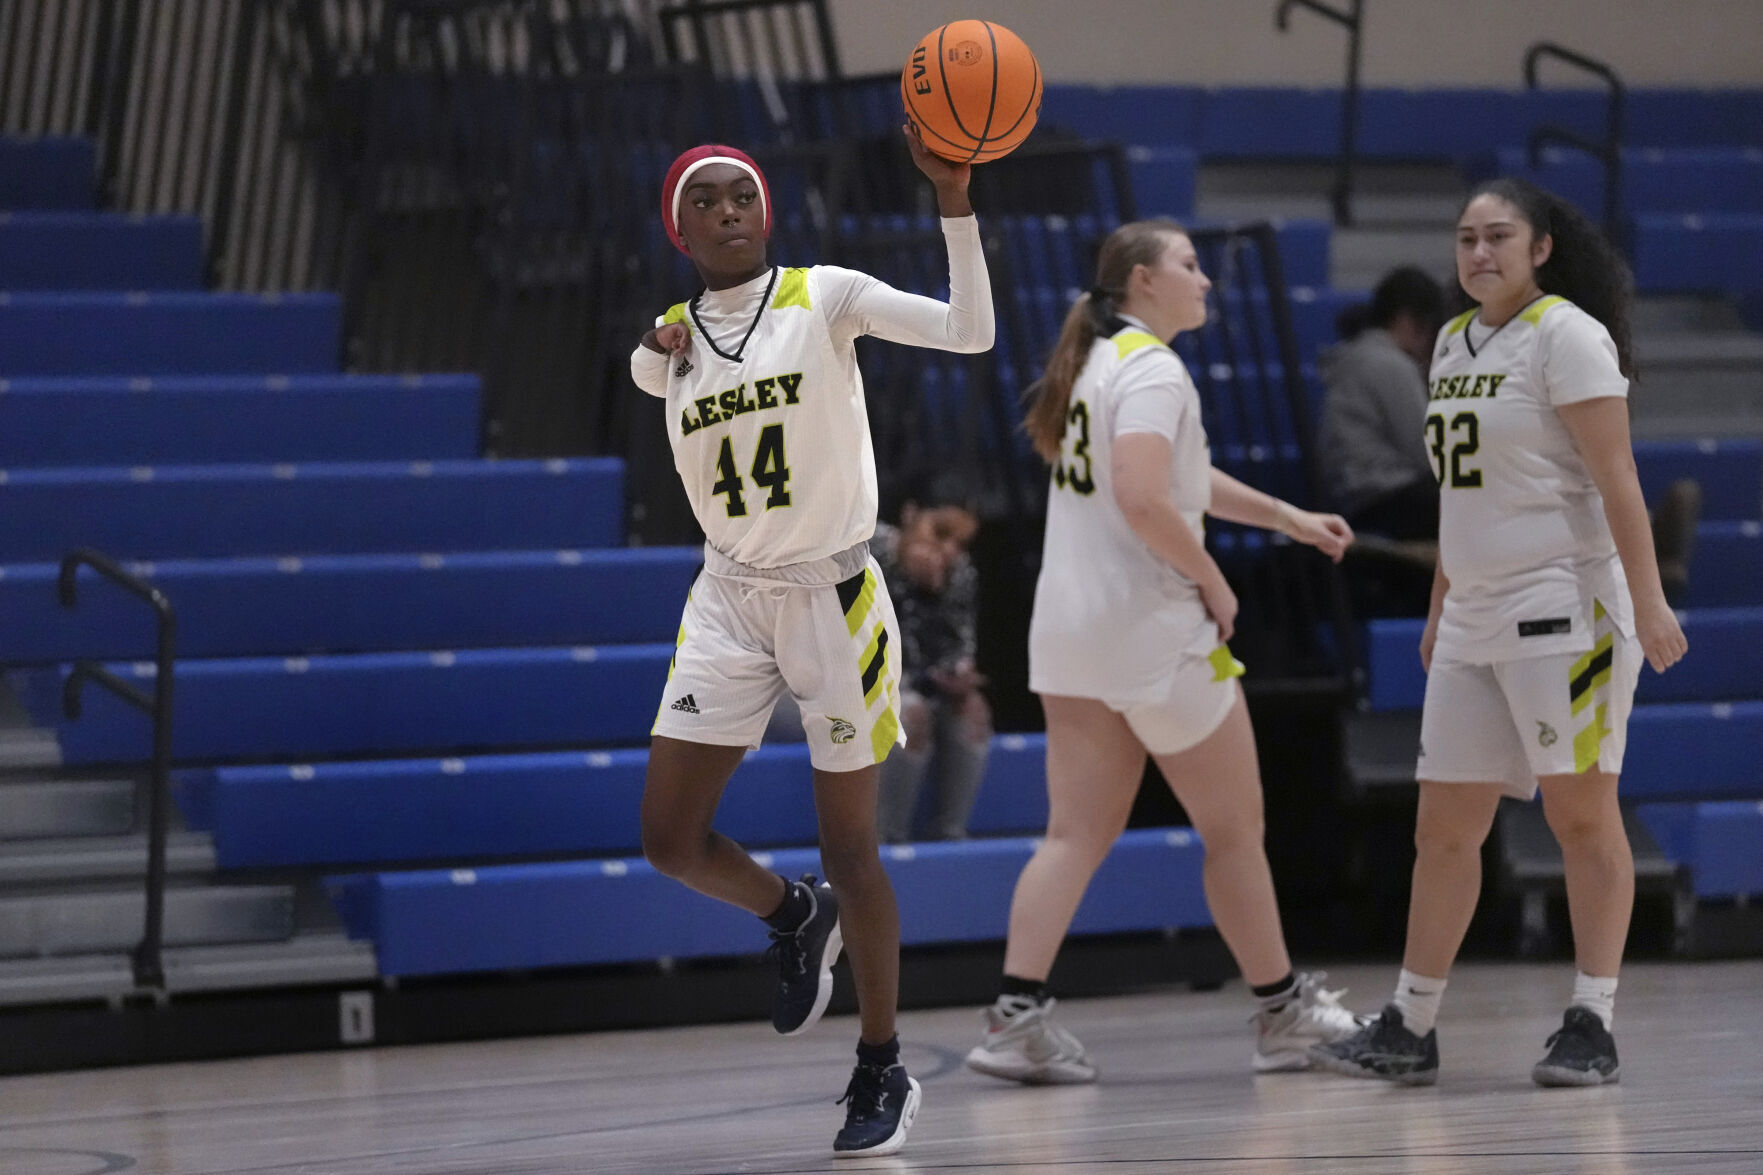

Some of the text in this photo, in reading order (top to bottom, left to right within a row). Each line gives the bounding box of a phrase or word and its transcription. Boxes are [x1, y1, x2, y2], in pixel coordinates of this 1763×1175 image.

[681, 372, 803, 437] LESLEY
[1430, 374, 1506, 401] ESLEY
[712, 422, 792, 518] 44
[1055, 399, 1095, 496] 3
[1424, 411, 1483, 489] 32
[671, 704, 700, 714] adidas
